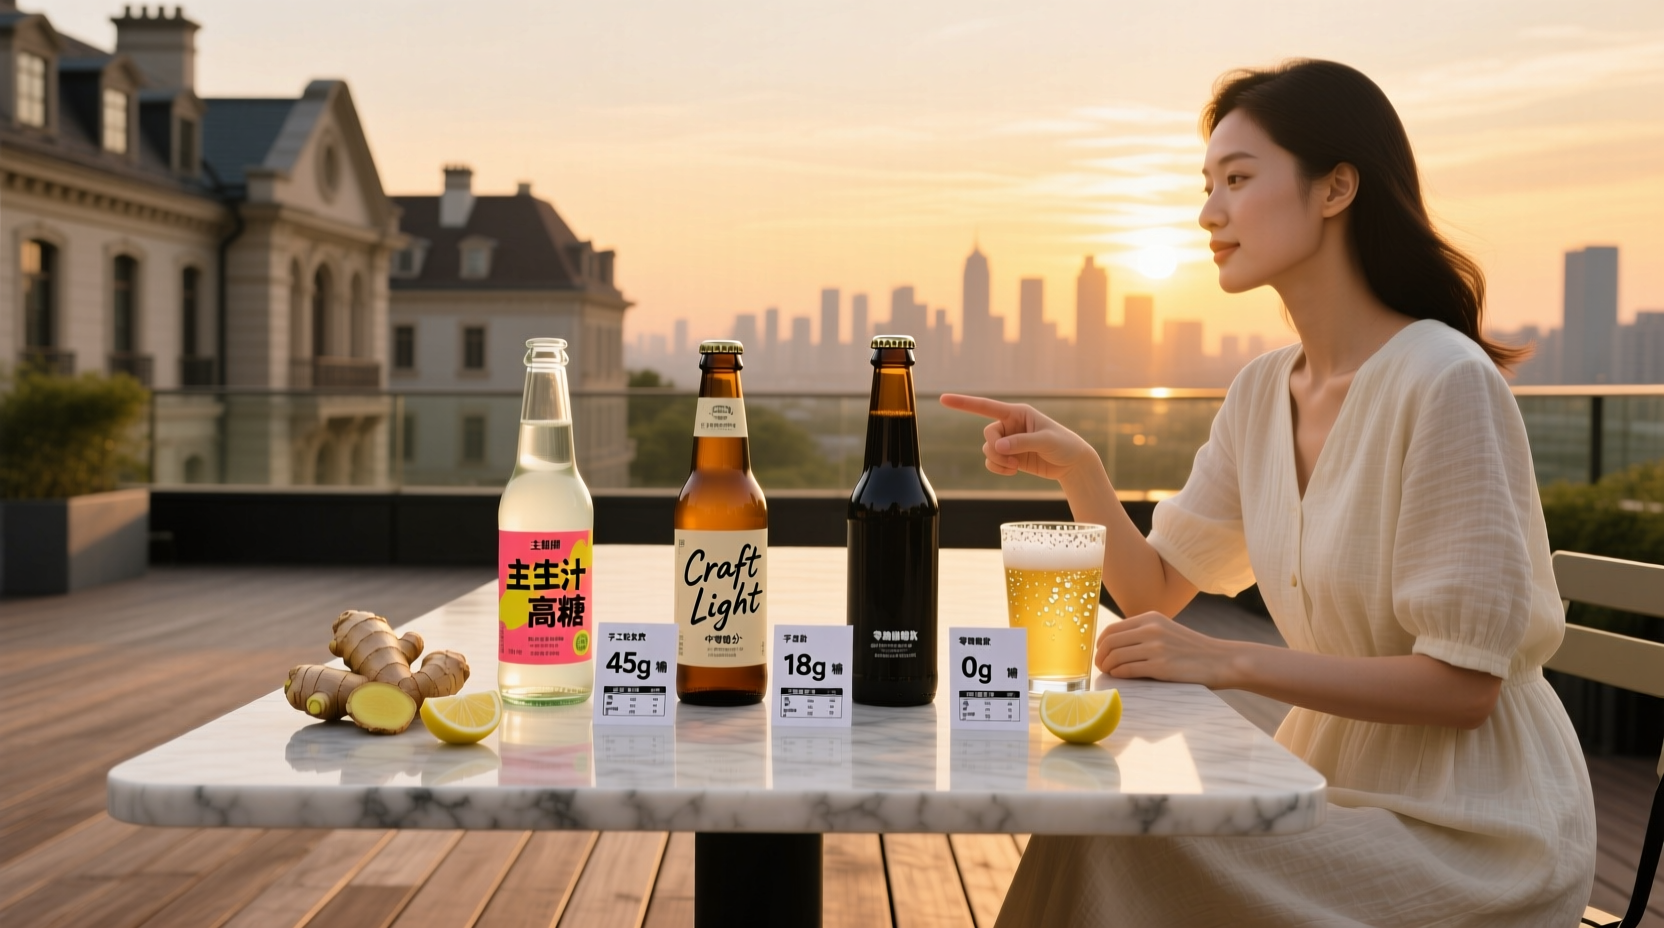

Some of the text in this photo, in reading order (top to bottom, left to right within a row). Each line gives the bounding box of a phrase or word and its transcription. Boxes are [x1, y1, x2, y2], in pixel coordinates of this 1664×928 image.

[684, 543, 762, 590] Craft
[528, 594, 586, 628] 高糖
[690, 581, 763, 631] Light
[605, 651, 651, 680] 45g
[784, 653, 826, 681] 18g
[961, 656, 992, 684] 0g
